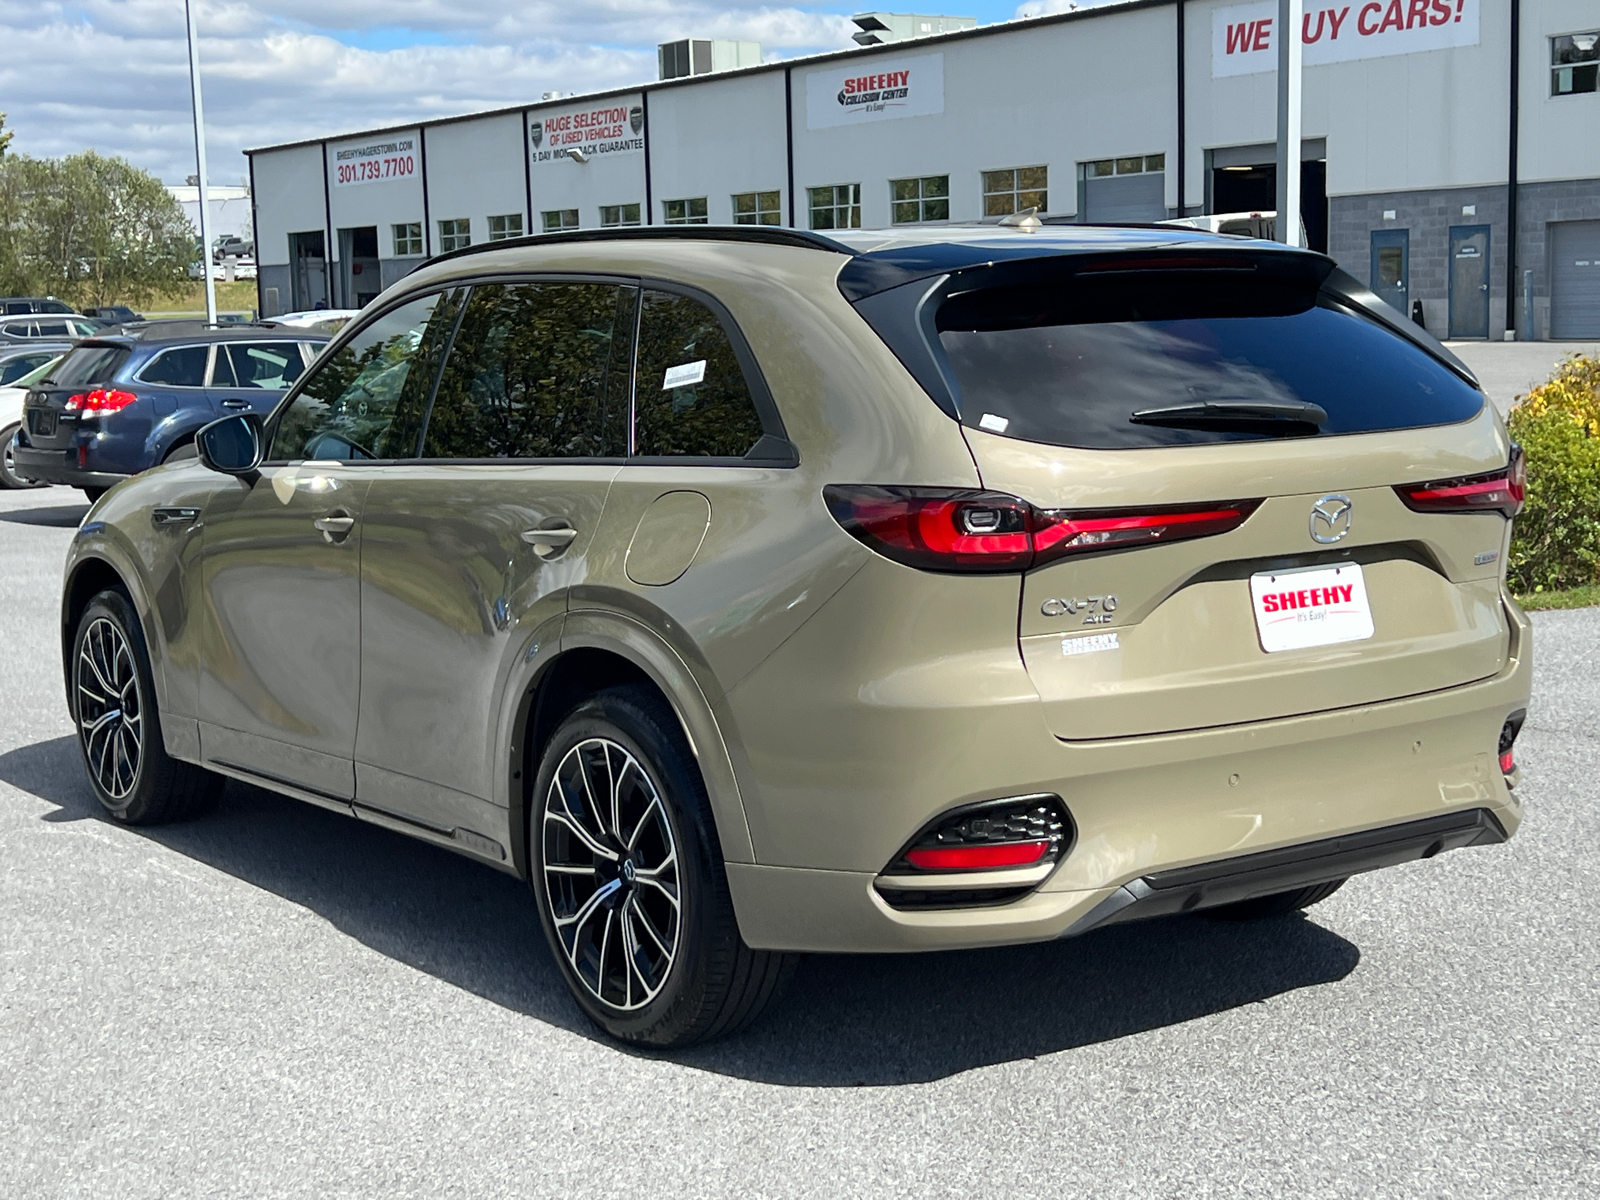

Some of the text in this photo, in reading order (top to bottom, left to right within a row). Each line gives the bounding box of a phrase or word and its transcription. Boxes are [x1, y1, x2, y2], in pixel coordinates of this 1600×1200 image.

[1226, 0, 1464, 54] WE UY CARS!
[844, 70, 910, 94] SHEEHY
[845, 88, 909, 106] COLLISION CENTER
[545, 107, 628, 133] HUGE SELECTION
[550, 125, 623, 146] OF USED VEHICLES
[337, 141, 413, 161] SHEEHYHAGERSTOWN.COM
[532, 152, 537, 162] 5
[538, 151, 552, 161] DAY
[599, 138, 644, 153] GUARANTEE
[338, 155, 414, 184] 301.739.7700
[1040, 594, 1118, 617] CX-70
[1262, 583, 1353, 613] SHEEHY
[1297, 609, 1327, 622] It's Easy!
[1061, 632, 1118, 650] SHEEHY
